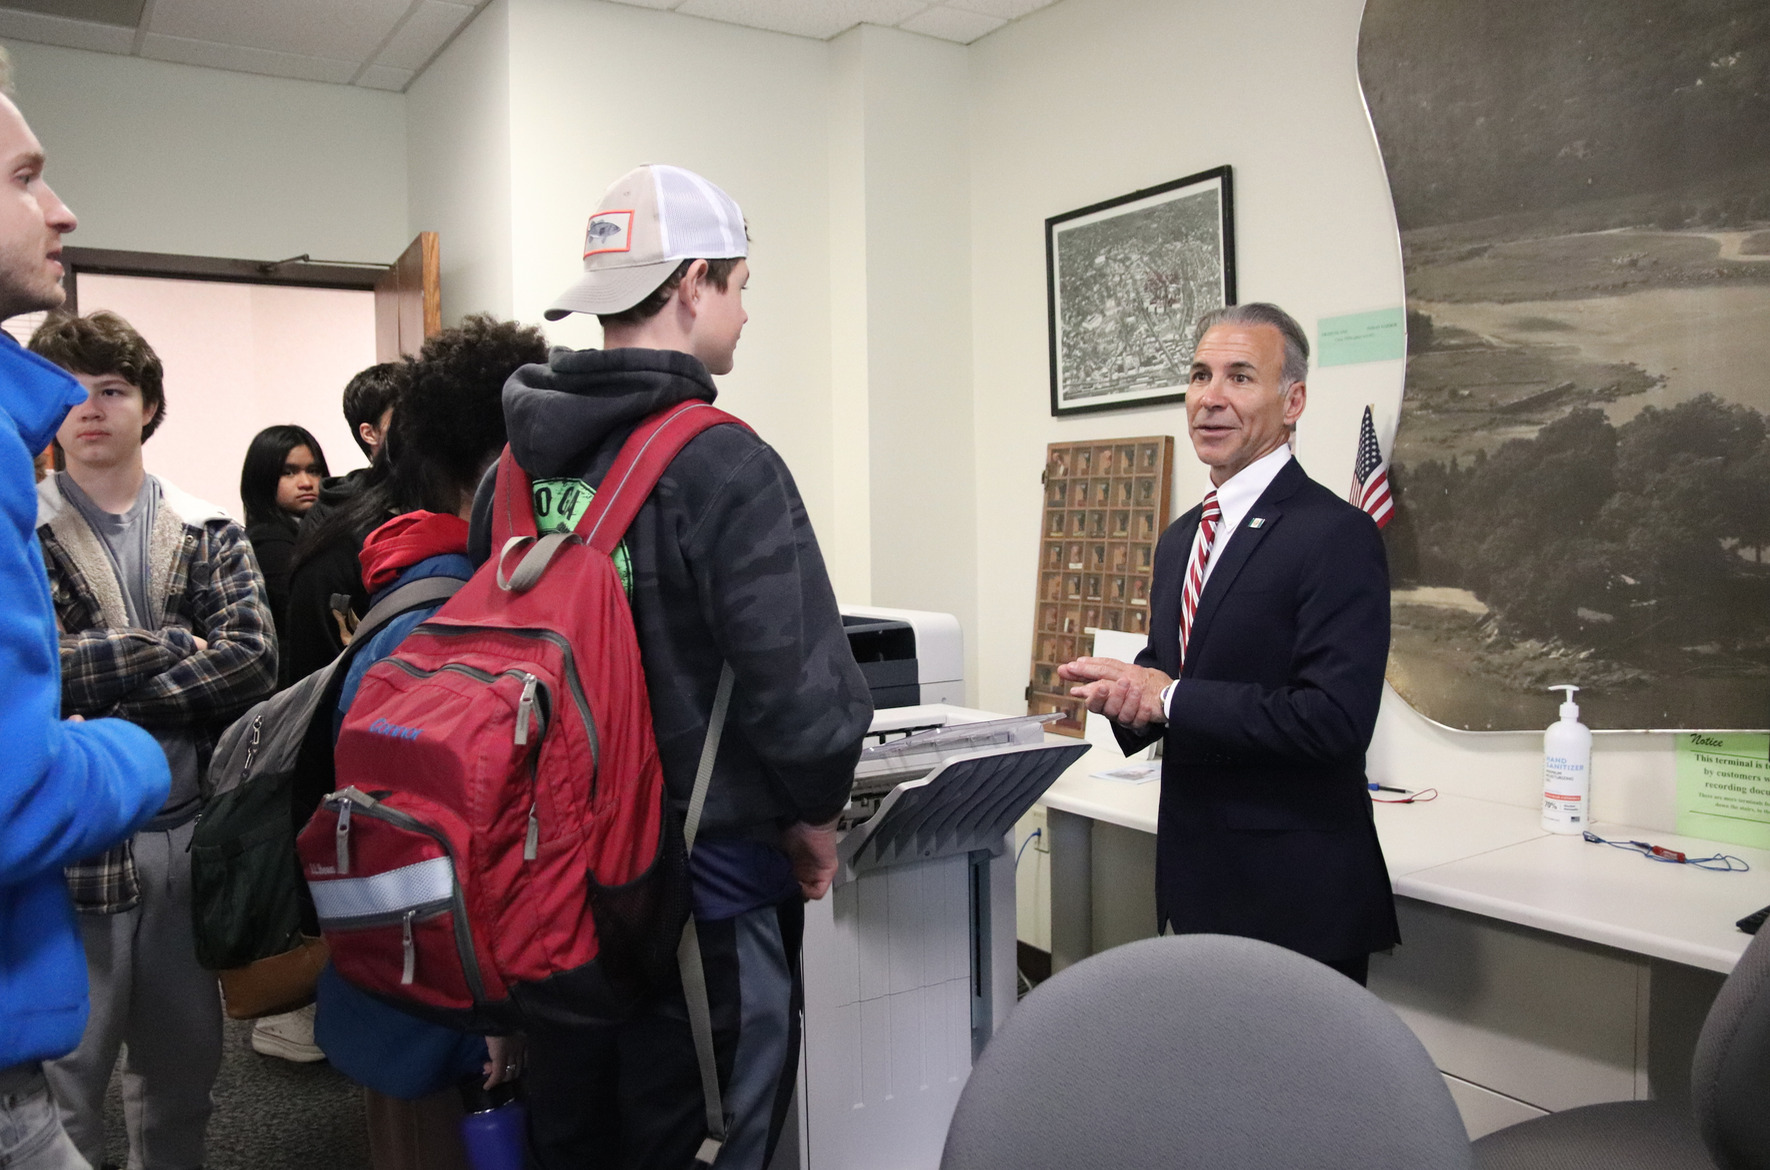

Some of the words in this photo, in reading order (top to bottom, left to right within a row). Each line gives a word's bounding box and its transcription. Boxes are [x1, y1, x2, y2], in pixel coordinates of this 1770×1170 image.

[1690, 733, 1723, 747] Notice
[1546, 756, 1567, 764] HAND
[1695, 754, 1713, 763] This
[1715, 757, 1753, 768] terminal
[1755, 761, 1762, 769] is
[1546, 763, 1584, 771] SANITIZER
[1704, 767, 1714, 778] by
[1716, 770, 1761, 782] customers
[1705, 781, 1747, 794] recording
